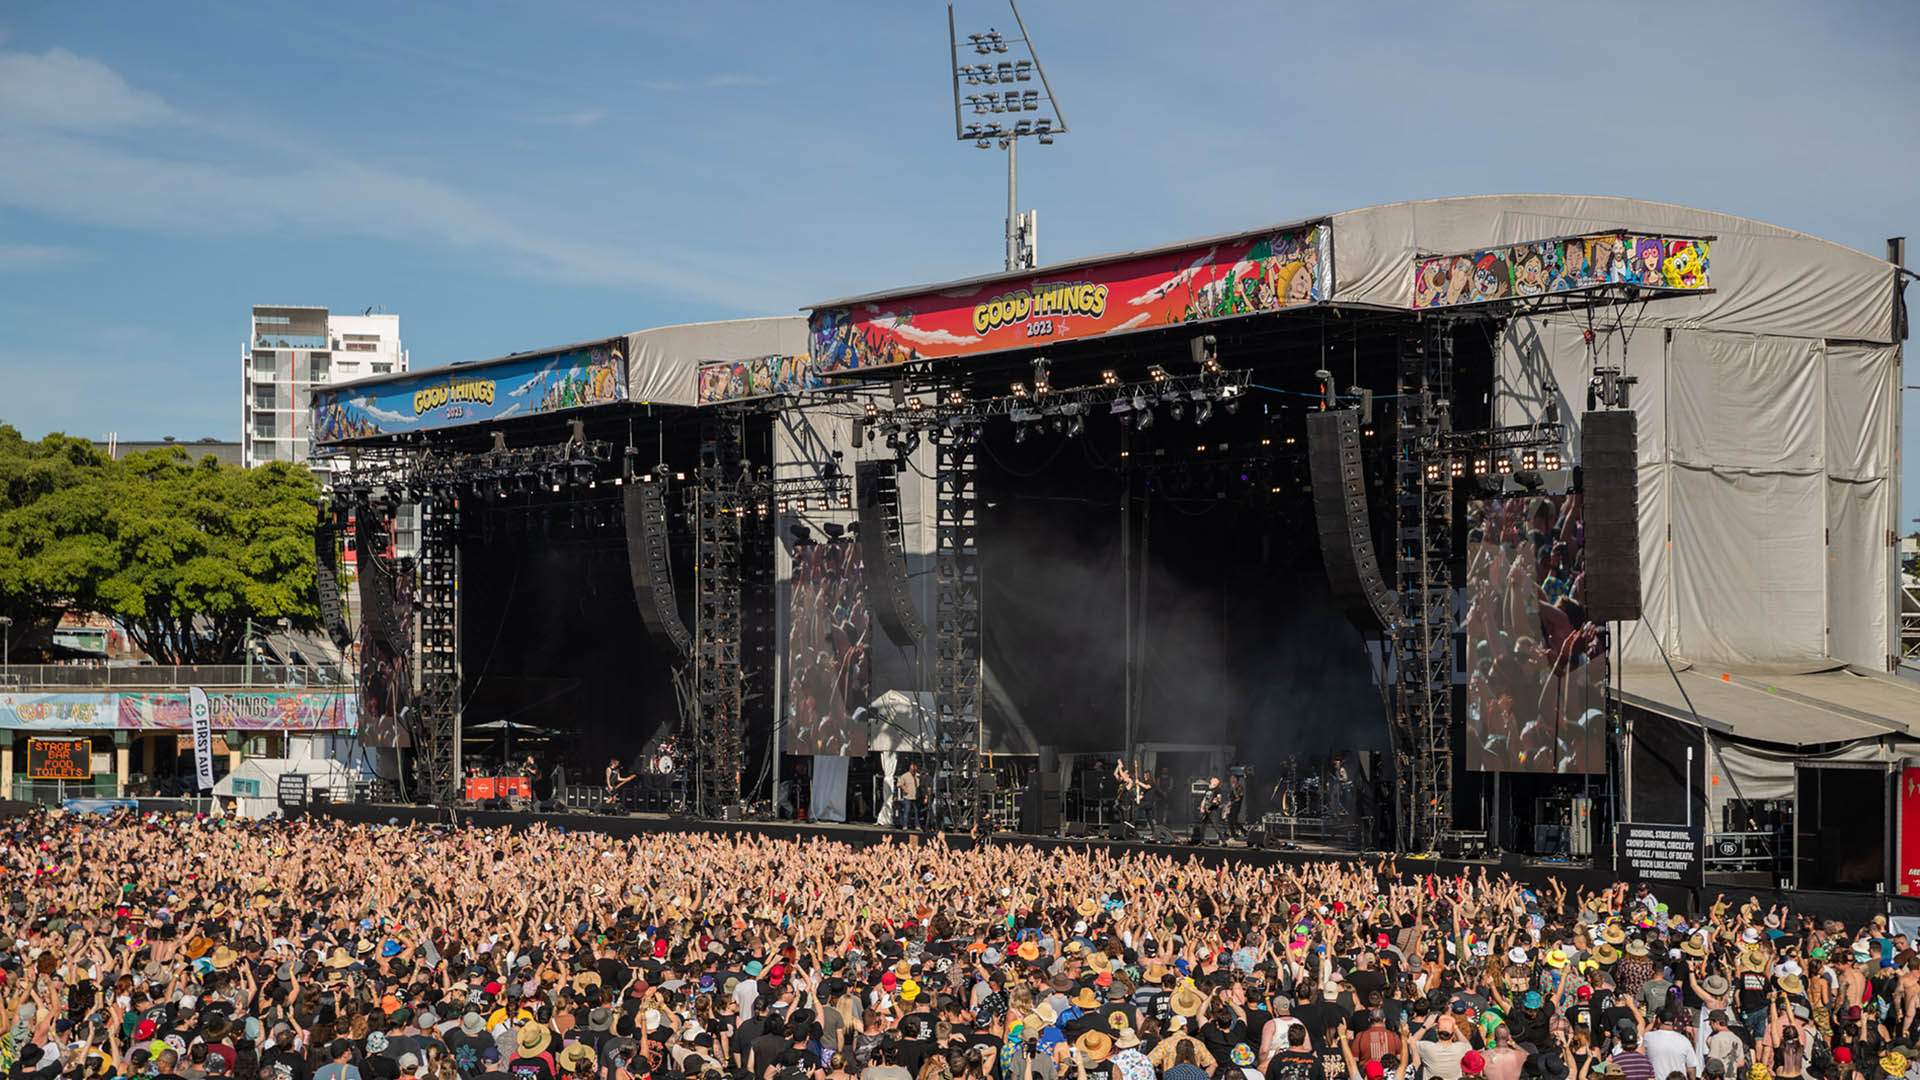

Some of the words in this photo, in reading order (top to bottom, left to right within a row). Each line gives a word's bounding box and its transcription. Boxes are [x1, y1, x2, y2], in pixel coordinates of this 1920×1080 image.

[974, 289, 1031, 335] GOOD
[1032, 282, 1108, 319] THINGS
[1027, 321, 1053, 336] 2023
[414, 385, 449, 416] GOOD
[450, 379, 496, 406] THINGS
[447, 407, 463, 419] 2023
[196, 719, 208, 753] FIRST
[34, 742, 71, 751] STAGE
[74, 742, 82, 751] 5
[48, 751, 71, 760] BAR
[45, 759, 74, 769] FOOD
[199, 756, 209, 778] AID
[35, 767, 83, 777] TOILETS
[1655, 830, 1671, 839] STAGE
[1626, 839, 1644, 847] CROWD
[1667, 841, 1685, 849] CIRCLE
[1685, 842, 1695, 850] PIT
[1626, 849, 1633, 857] OR
[1633, 849, 1650, 857] CIRCLE
[1654, 851, 1668, 859] WALL
[1668, 851, 1675, 859] OF
[1631, 859, 1639, 867] OR
[1640, 860, 1653, 868] SUCH
[1653, 860, 1664, 869] LIKE
[1665, 861, 1688, 870] ACTIVITY
[1639, 870, 1649, 878] ARE
